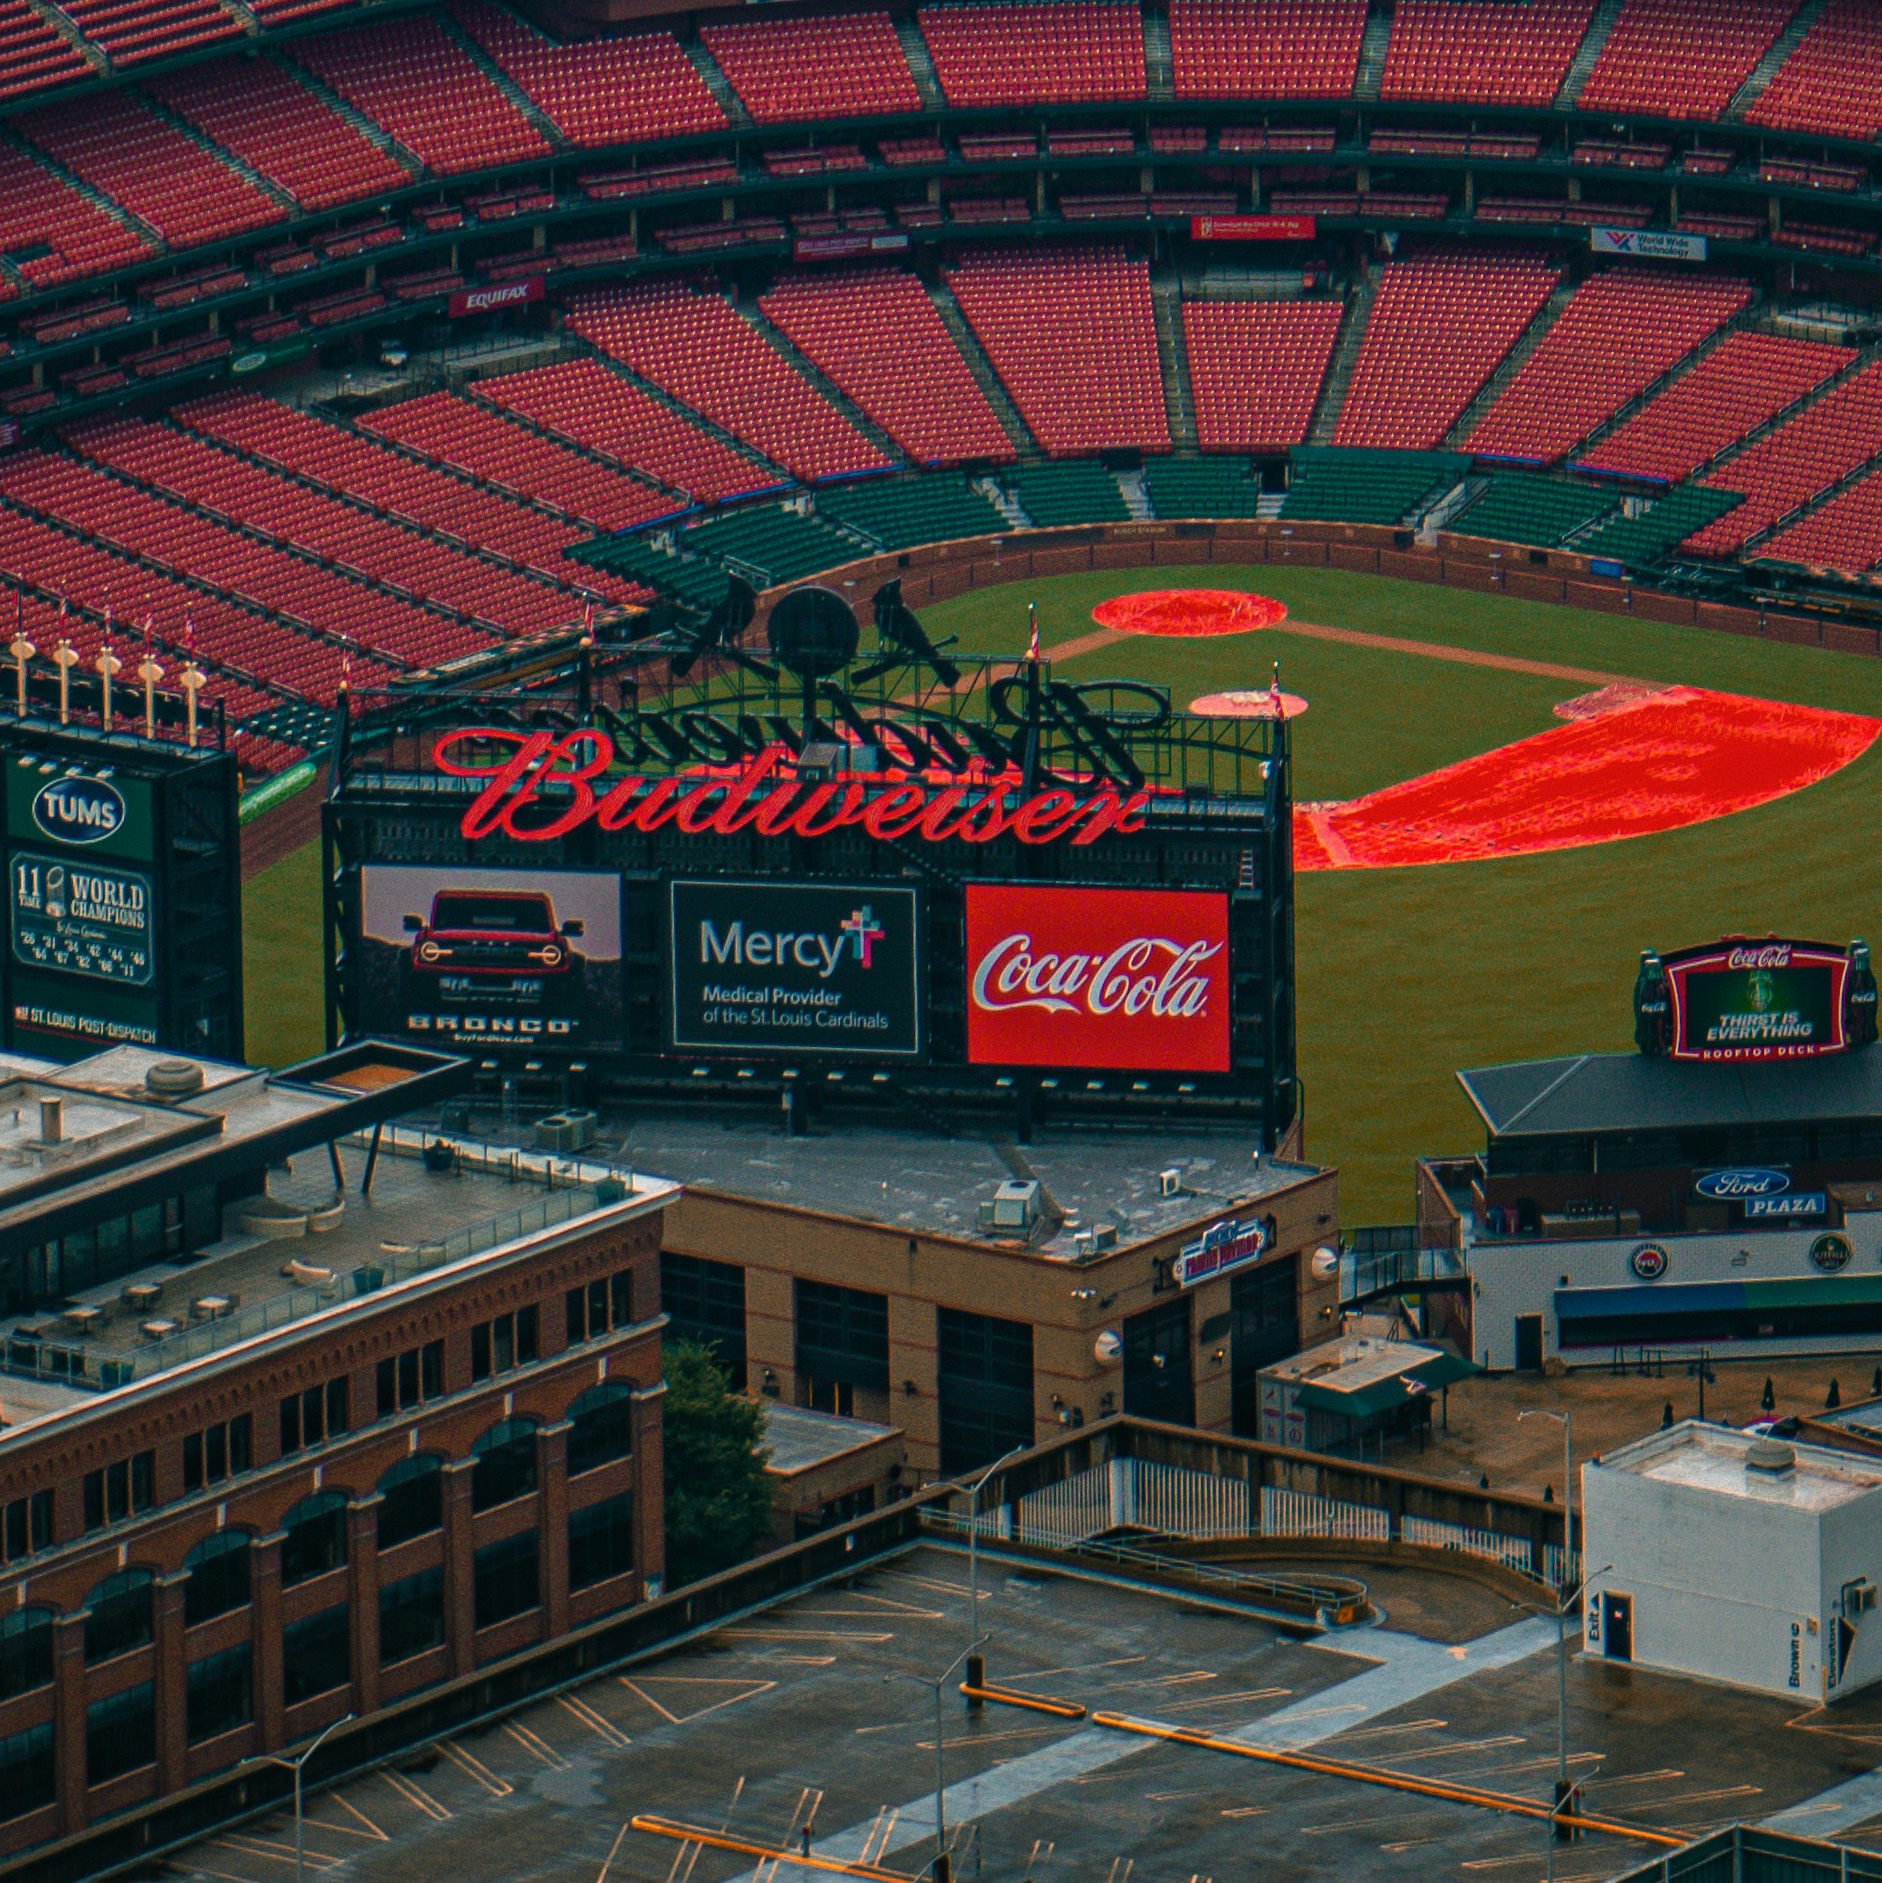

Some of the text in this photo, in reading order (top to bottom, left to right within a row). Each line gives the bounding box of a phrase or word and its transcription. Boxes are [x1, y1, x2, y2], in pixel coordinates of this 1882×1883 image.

[465, 283, 529, 309] EQUIFAX
[432, 726, 1150, 846] Budweiser
[43, 791, 117, 830] TUMS
[18, 863, 41, 897] 11
[70, 873, 145, 911] WORLD
[70, 898, 145, 930] CHAMPIONS
[699, 919, 847, 979] Mercy
[1727, 943, 1793, 969] Coca-Cola
[972, 932, 1225, 1018] Coca-Cola
[703, 984, 843, 1007] Medical Provider
[47, 1010, 77, 1032] LOUIS
[77, 1016, 157, 1045] POST-DISPATCH
[703, 1006, 721, 1024] of
[722, 1006, 748, 1025] the
[771, 1009, 813, 1027] Louis
[814, 1010, 889, 1030] Cardinals
[1706, 1022, 1813, 1042] EVERYTHING
[1719, 1010, 1799, 1028] THIRST IS
[1703, 1044, 1816, 1060] ROOFTOP DECK
[1714, 1173, 1771, 1195] Ford
[1751, 1197, 1818, 1215] PLAZA
[1589, 1610, 1601, 1642] Exit
[1789, 1638, 1801, 1688] Brown
